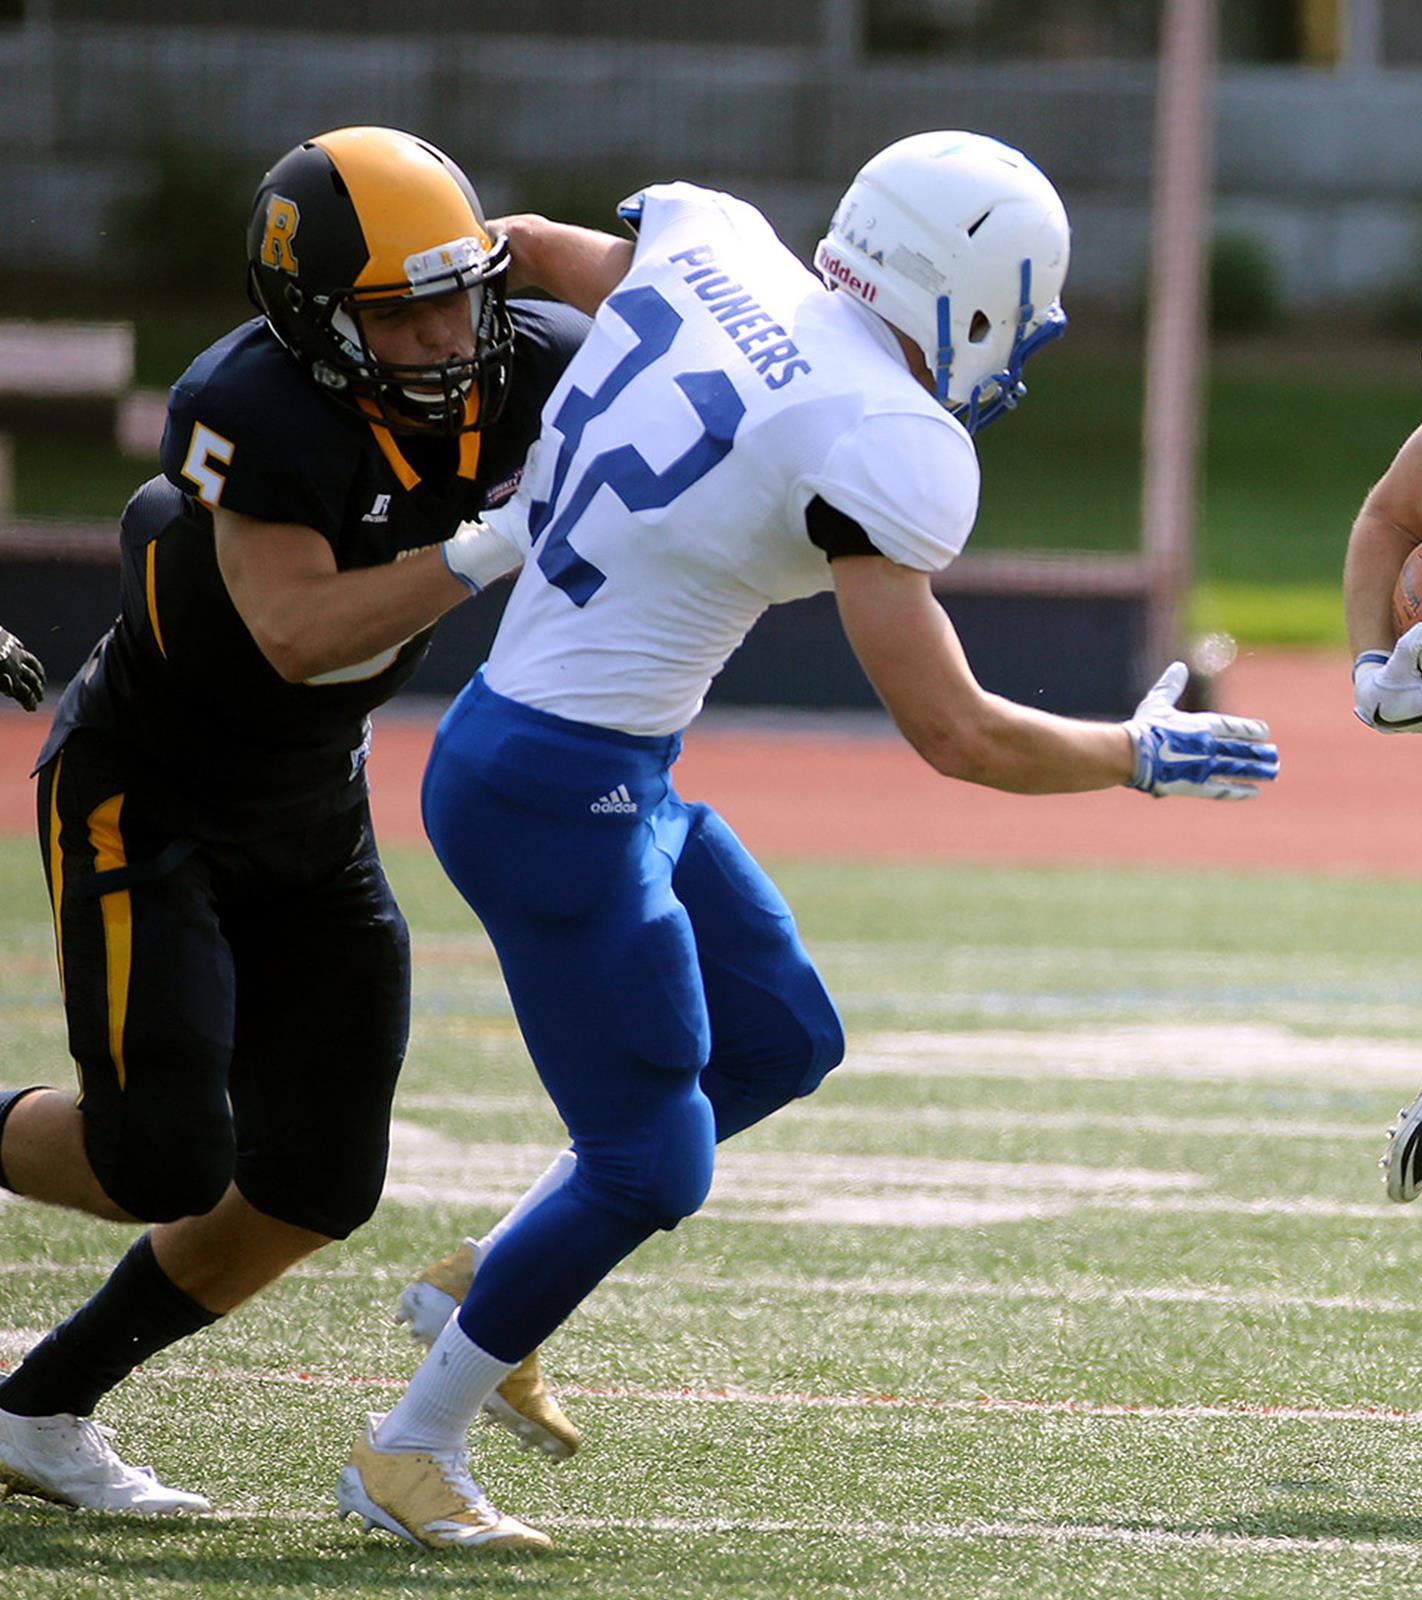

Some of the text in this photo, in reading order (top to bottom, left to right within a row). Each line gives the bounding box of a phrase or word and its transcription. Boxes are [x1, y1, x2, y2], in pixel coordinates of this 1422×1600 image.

[261, 193, 300, 277] R
[180, 420, 235, 513] 5
[528, 284, 747, 609] 32
[590, 801, 638, 814] adidas
